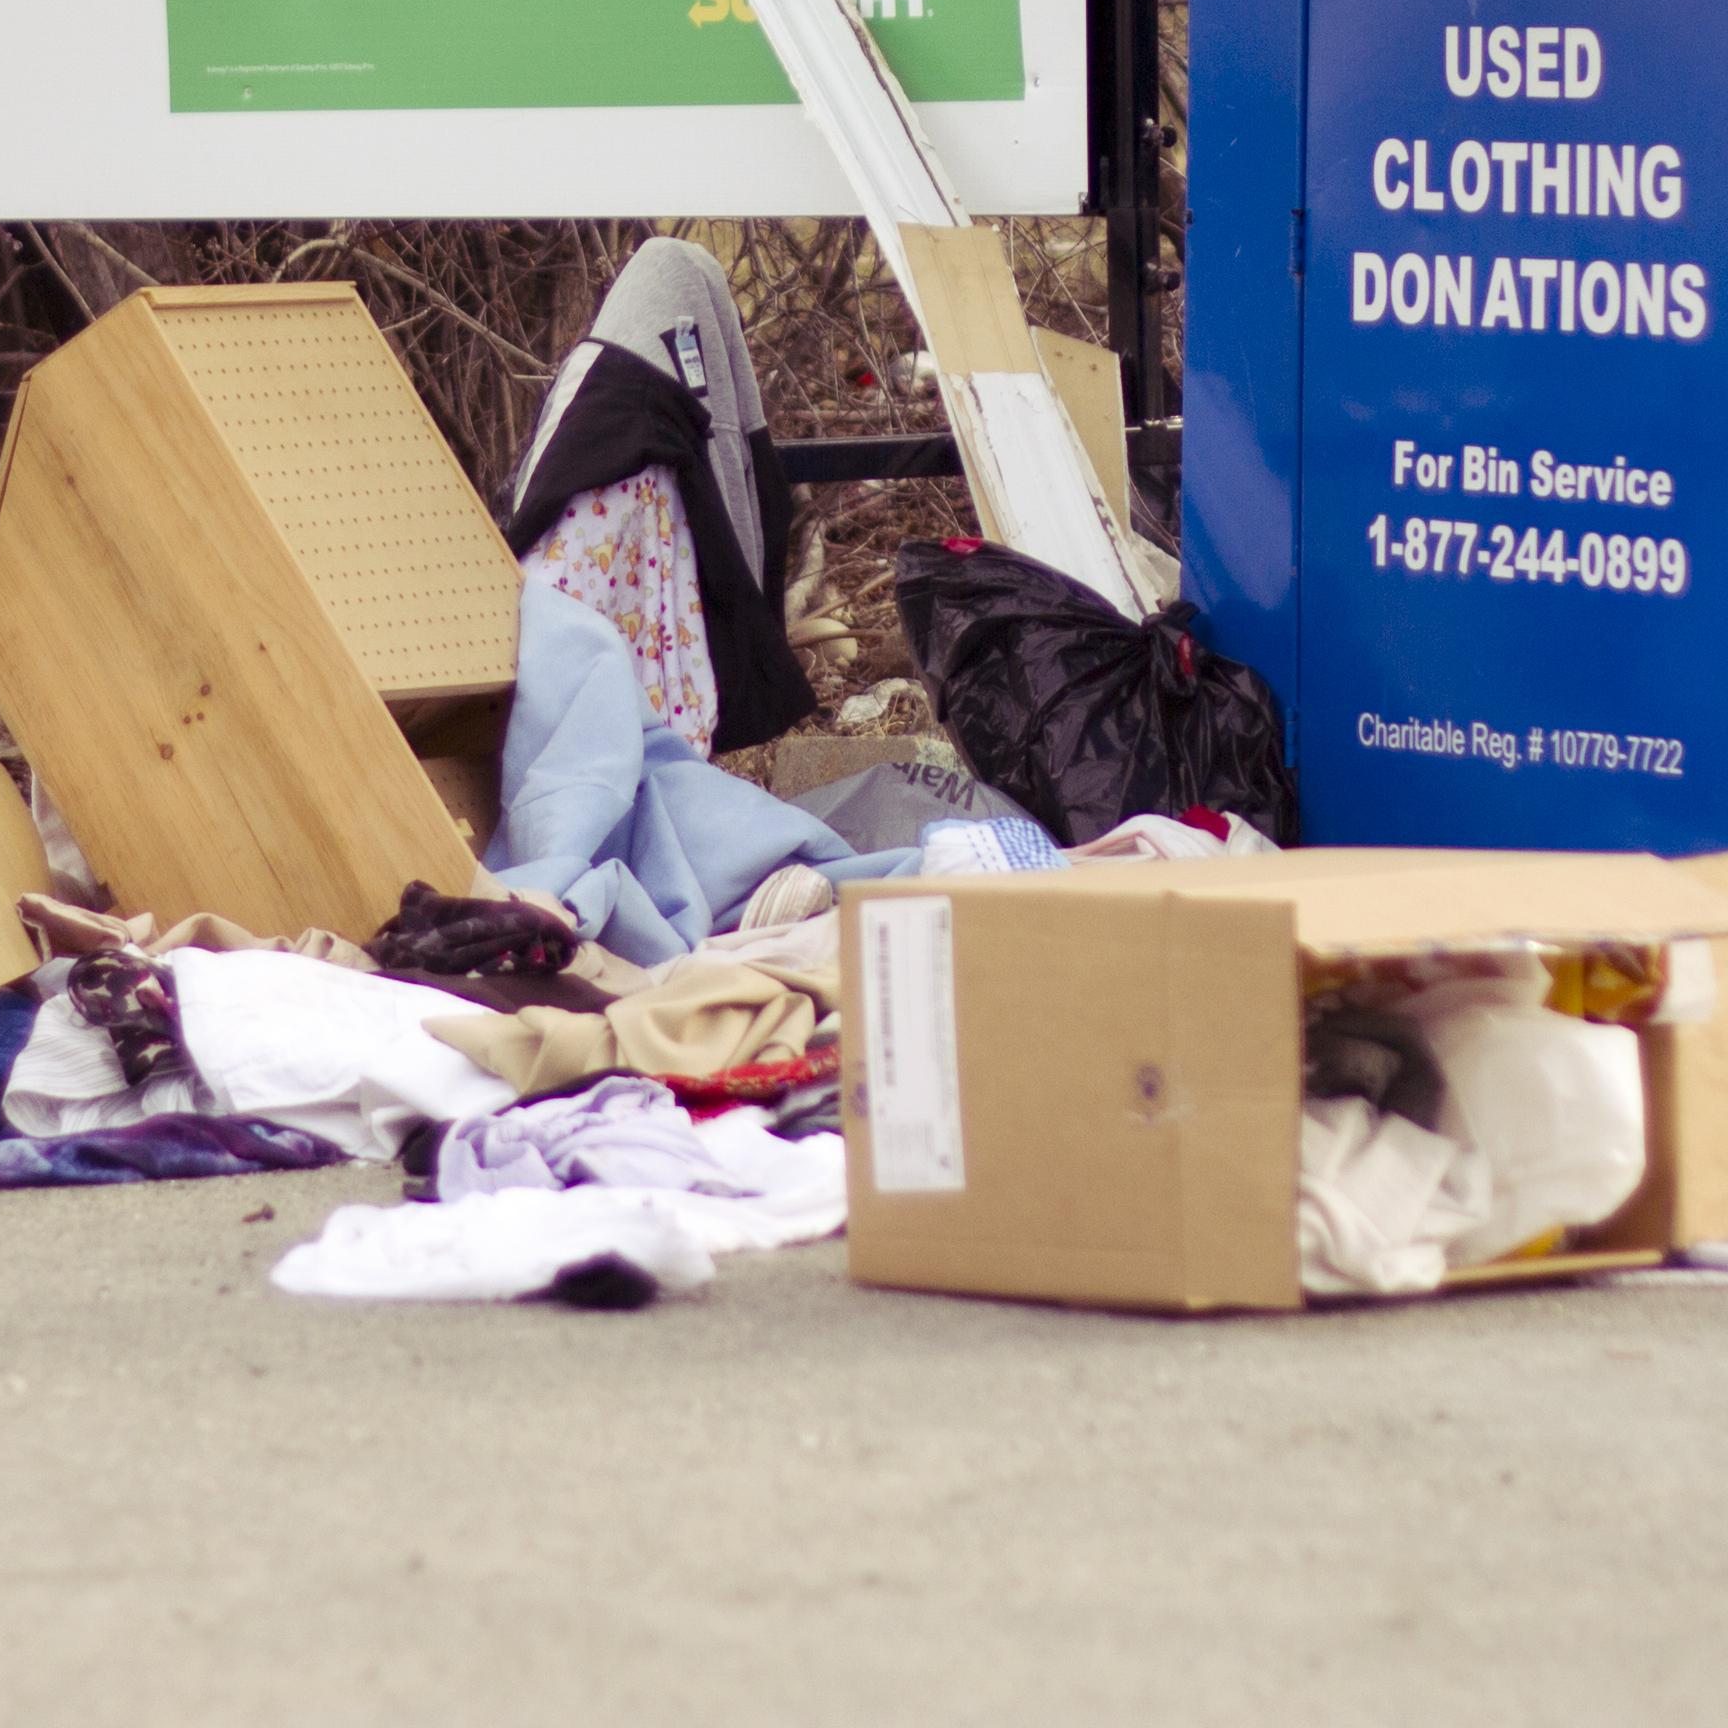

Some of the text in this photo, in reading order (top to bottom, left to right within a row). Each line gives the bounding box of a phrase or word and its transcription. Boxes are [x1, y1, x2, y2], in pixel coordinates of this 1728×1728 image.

[1445, 25, 1602, 100] USED
[1373, 138, 1682, 219] CLOTHING
[1352, 252, 1707, 339] DONATIONS
[1393, 440, 1672, 506] For Bin Service
[1368, 514, 1686, 594] 1-877-244-0899
[1358, 712, 1684, 775] Charitable Reg. # 10779-7722
